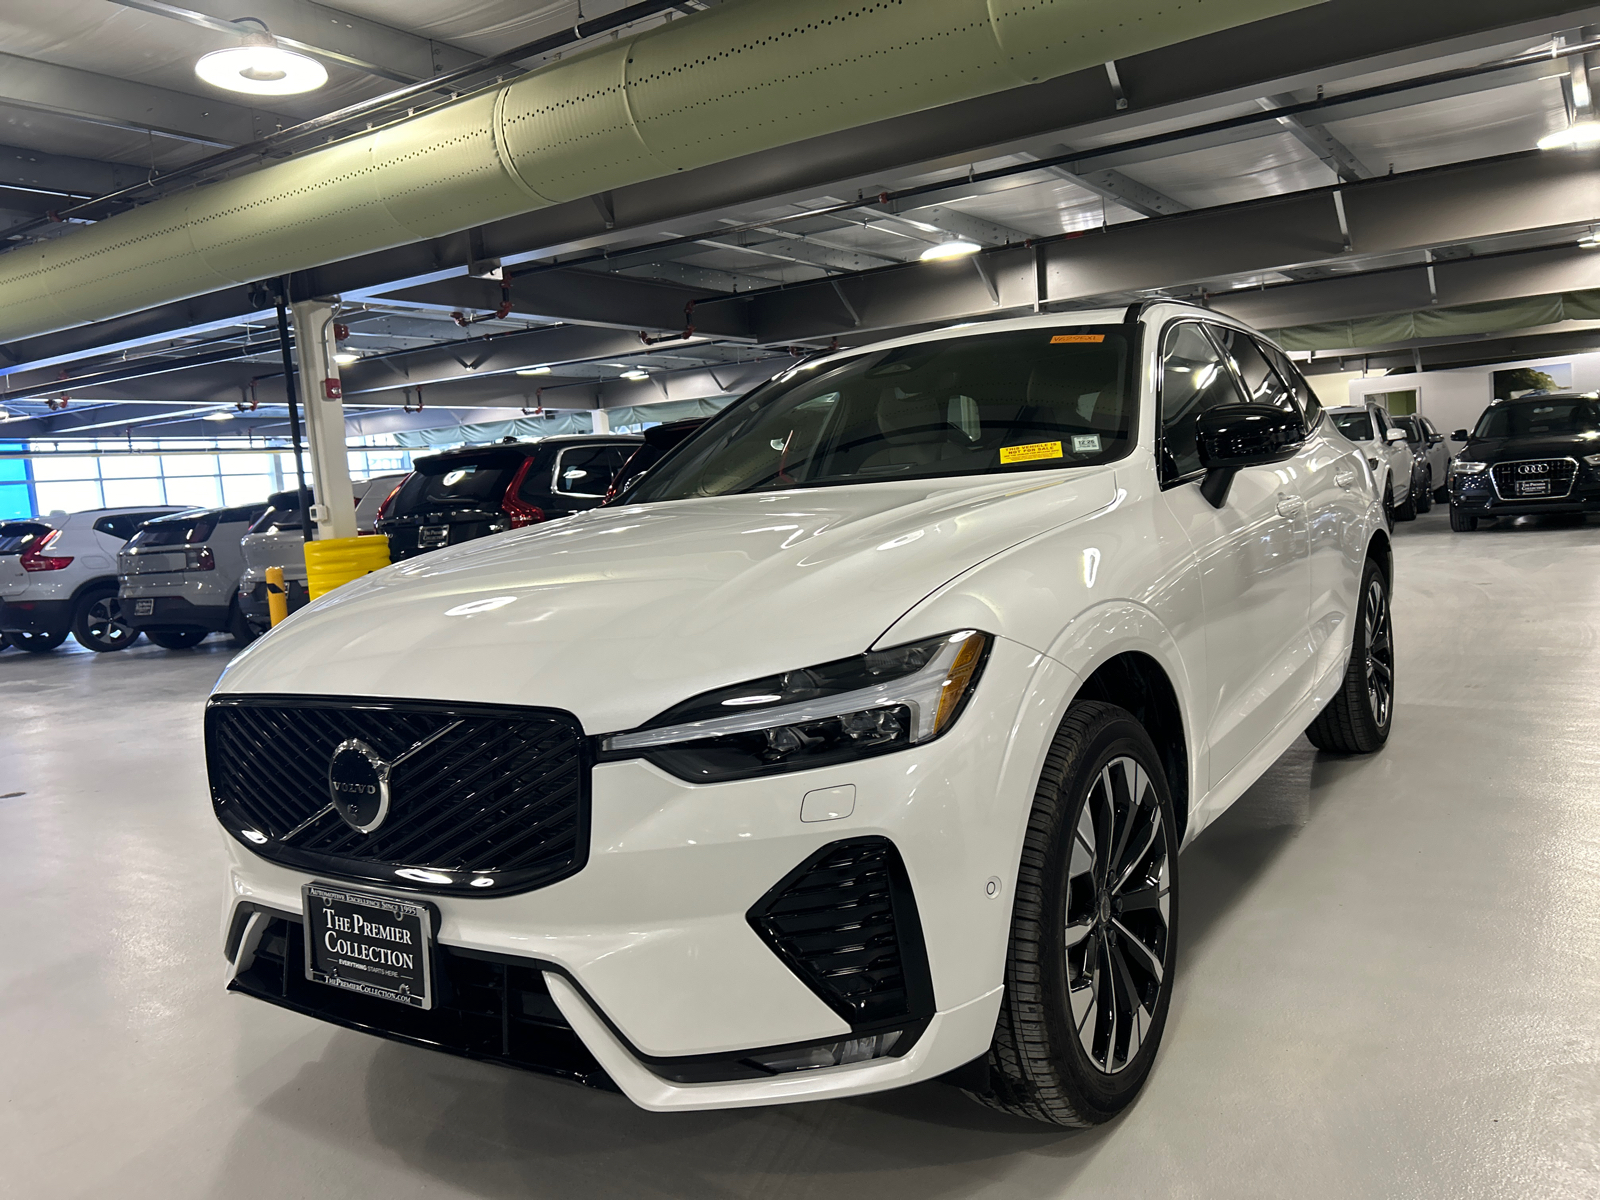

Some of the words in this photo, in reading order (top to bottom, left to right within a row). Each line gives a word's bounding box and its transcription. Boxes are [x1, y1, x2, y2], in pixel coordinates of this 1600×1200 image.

[332, 781, 376, 795] VOLVO
[310, 888, 345, 901] AUTOMOTIVE
[346, 894, 381, 907] EXCELLENCE
[381, 901, 398, 912] SINCE
[400, 905, 416, 915] 1995
[322, 908, 352, 933] THE
[352, 913, 412, 945] PREMIER
[324, 930, 414, 970] COLLECTION
[338, 958, 367, 971] EVERYTHING
